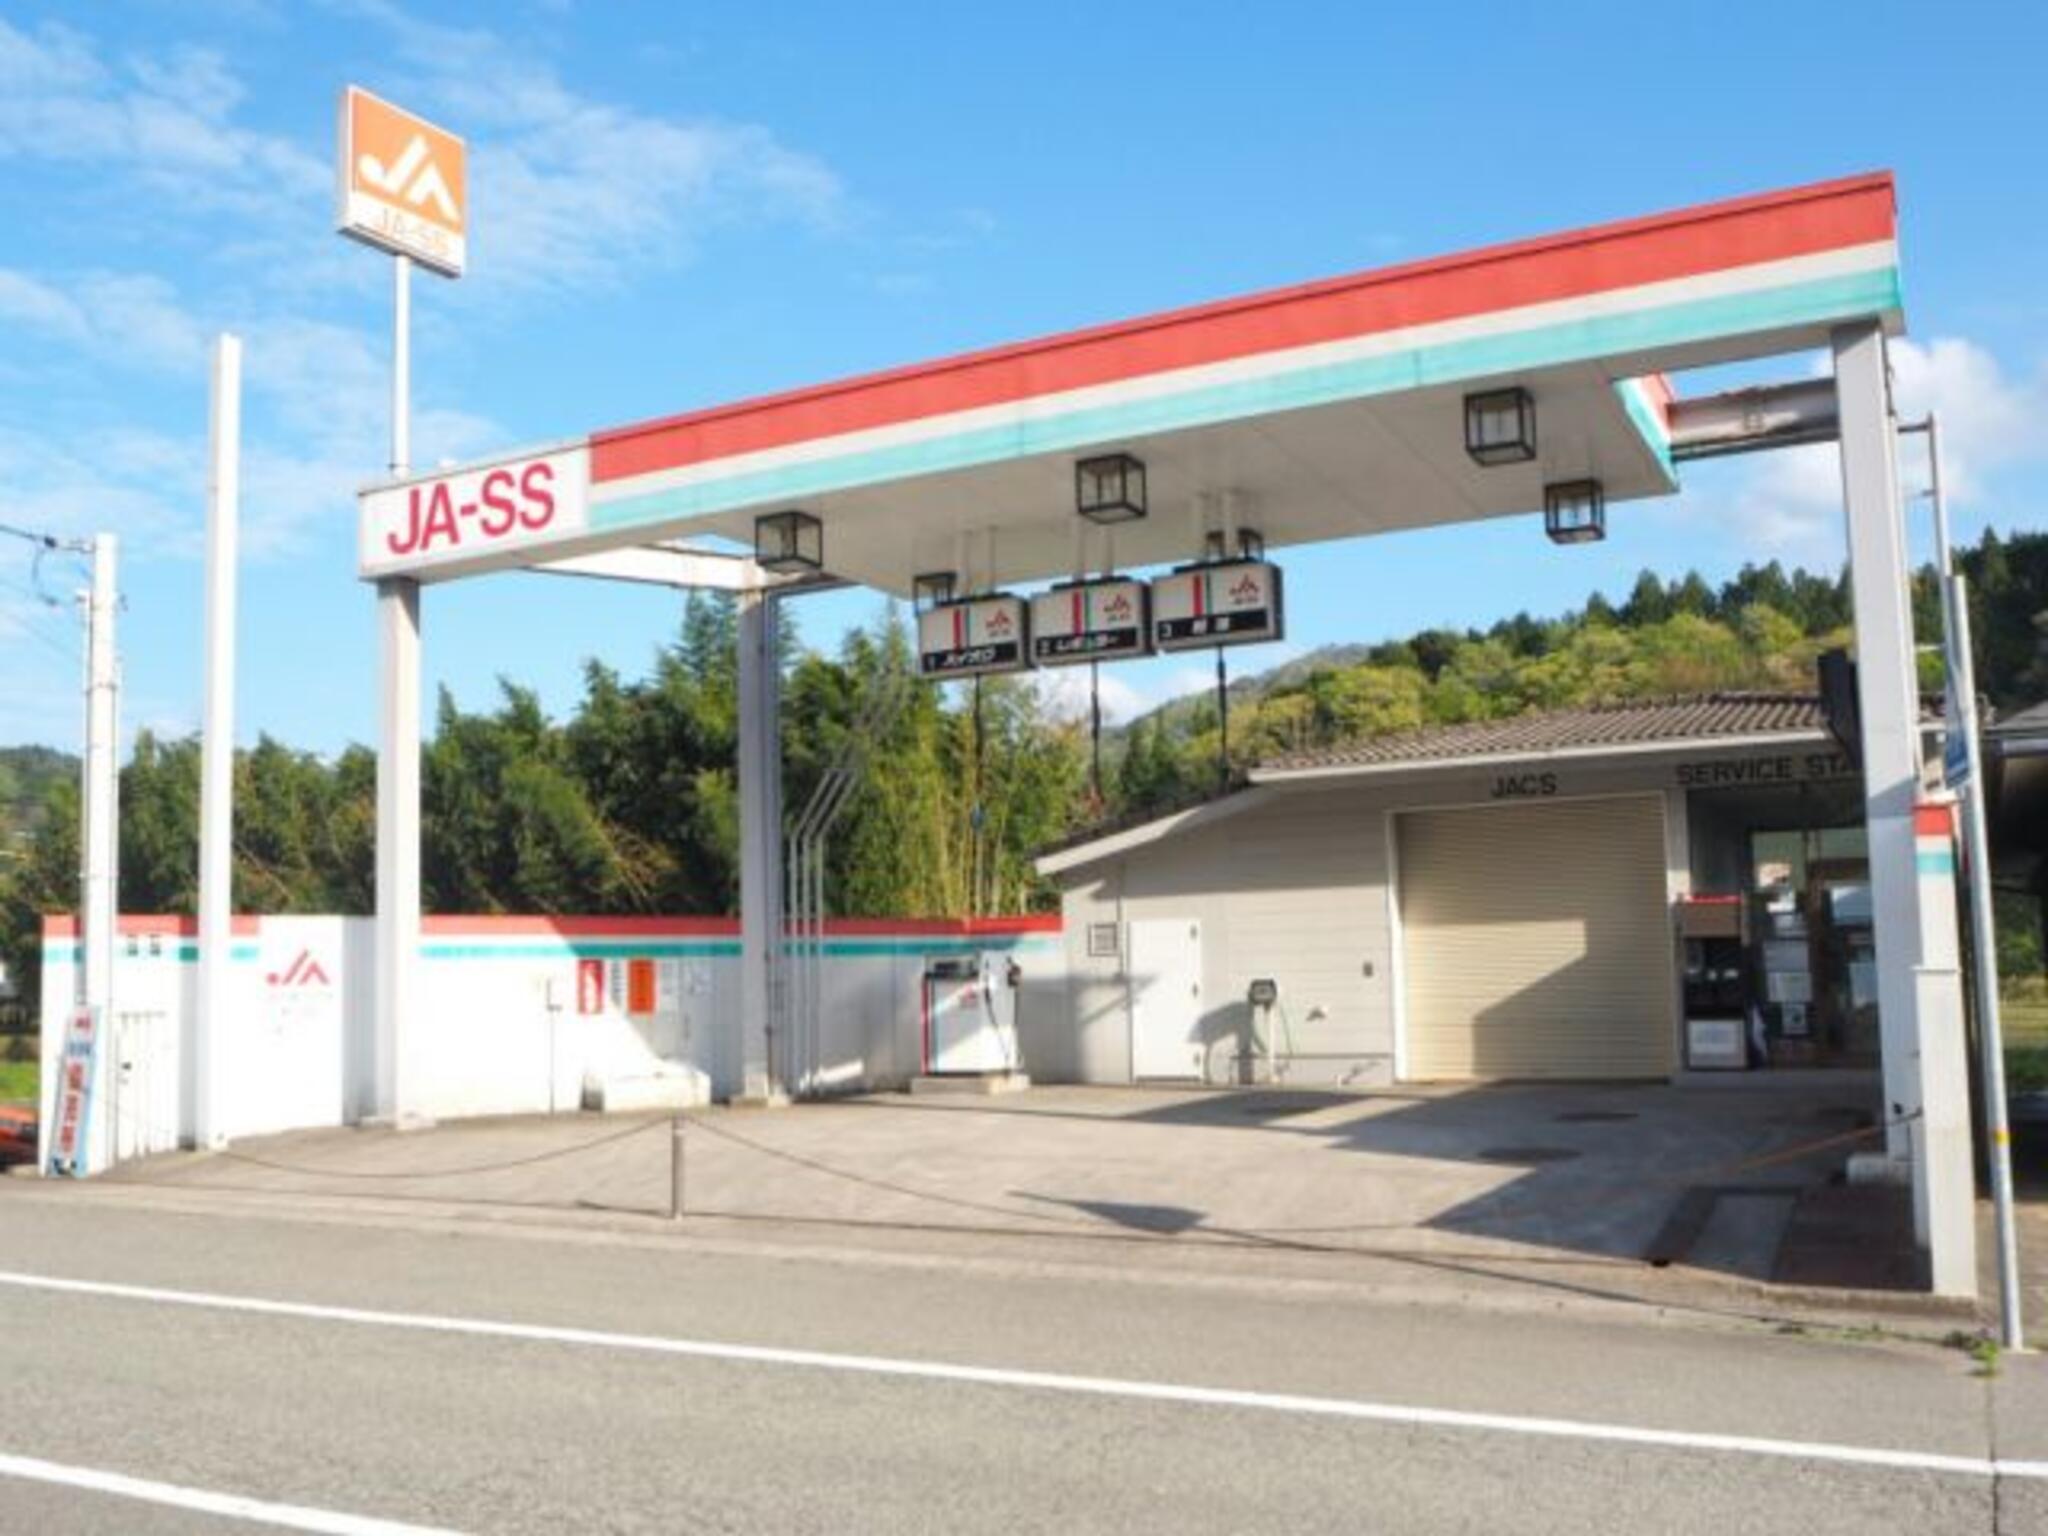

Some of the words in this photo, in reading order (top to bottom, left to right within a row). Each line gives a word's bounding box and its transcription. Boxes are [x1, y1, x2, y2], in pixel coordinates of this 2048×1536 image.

[387, 462, 555, 555] JA-SS
[1490, 770, 1557, 798] JACS
[1677, 754, 1793, 785] SERVICE
